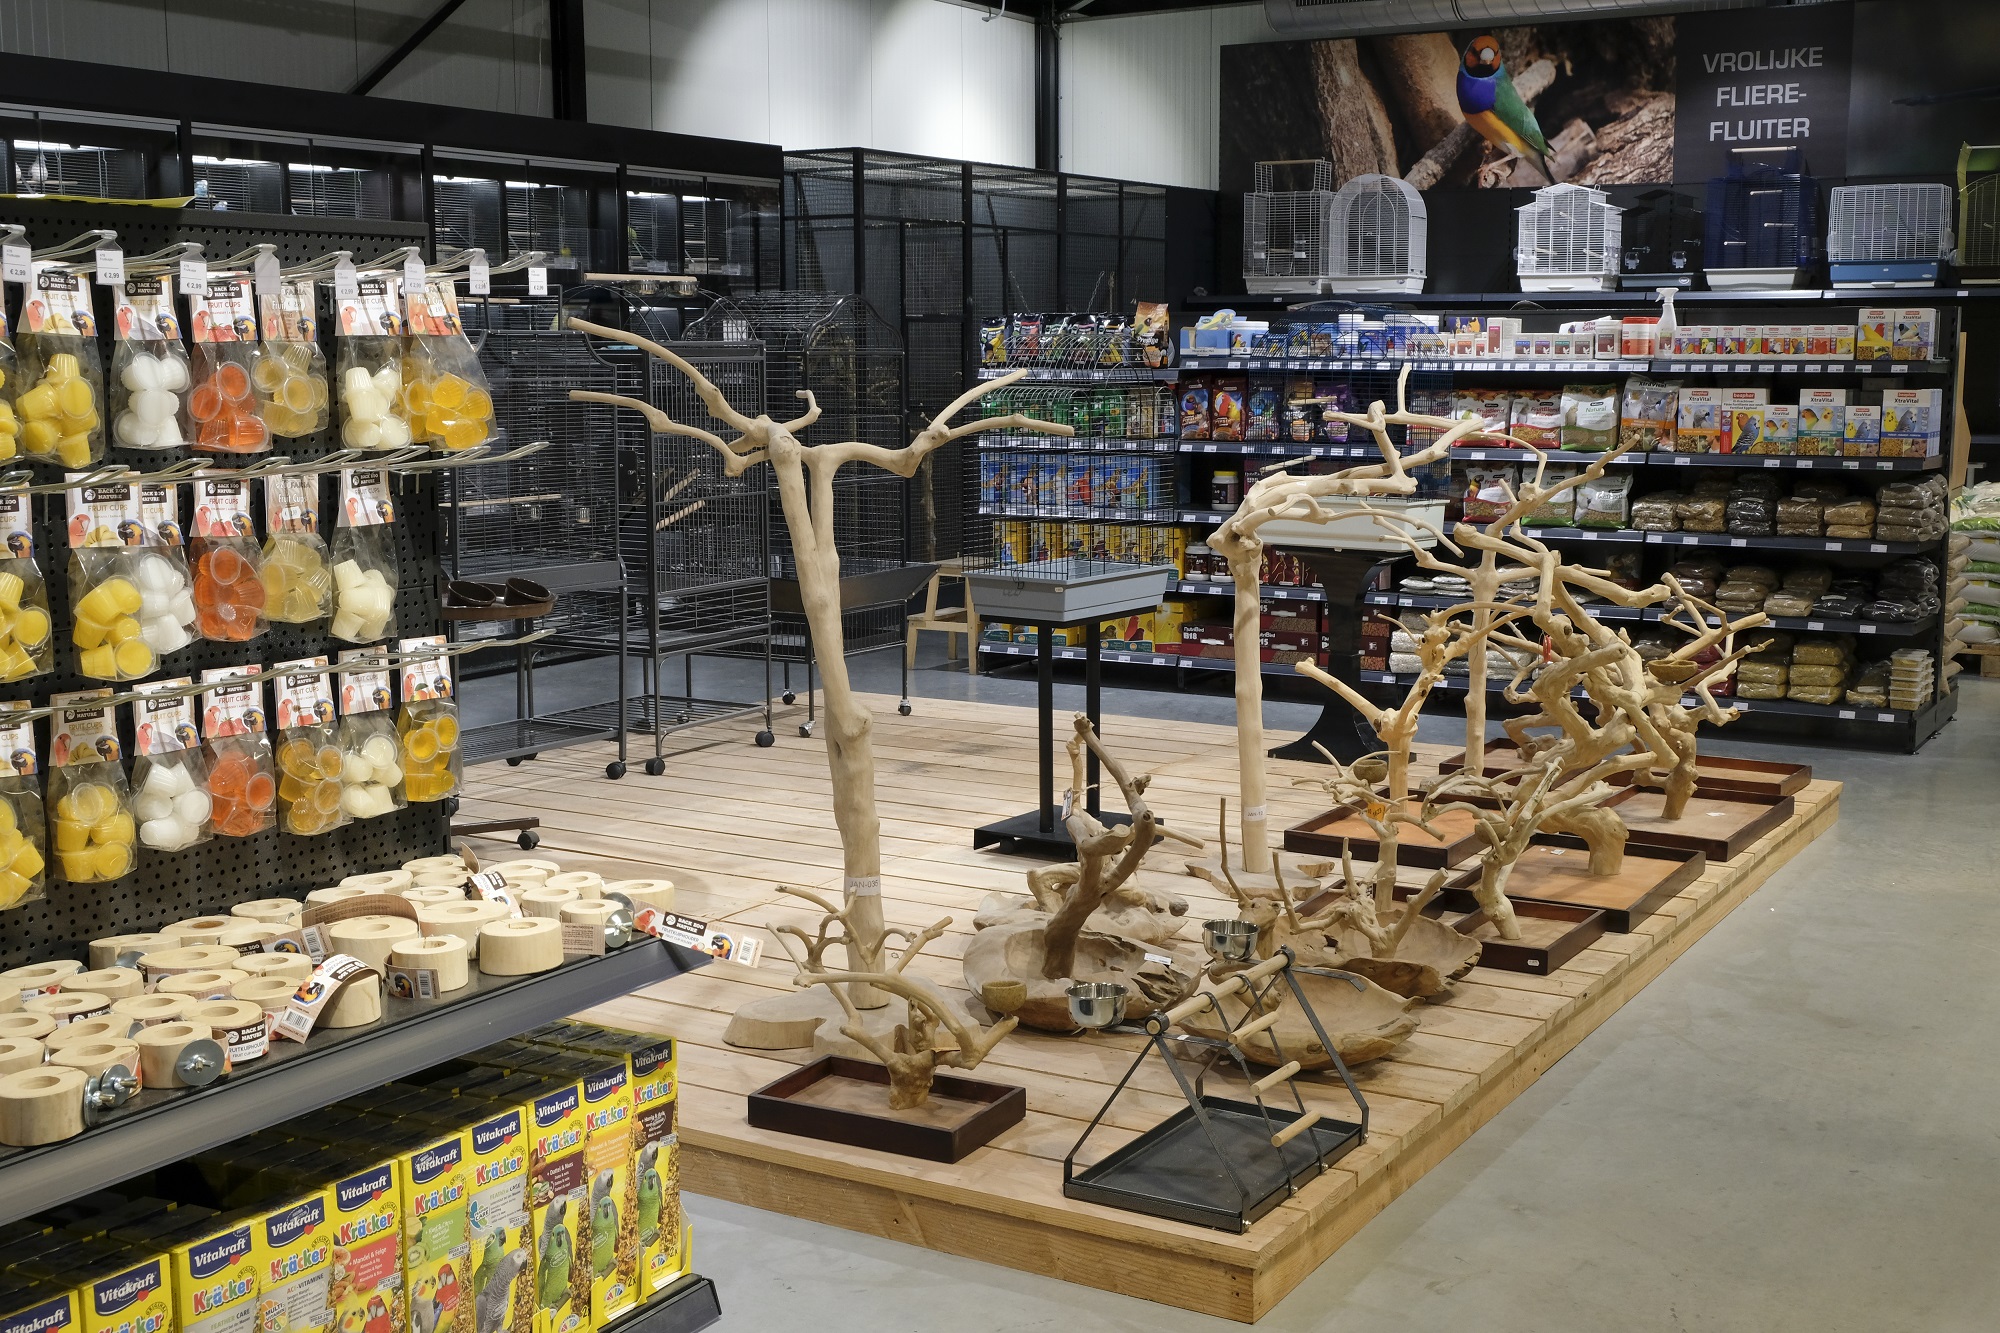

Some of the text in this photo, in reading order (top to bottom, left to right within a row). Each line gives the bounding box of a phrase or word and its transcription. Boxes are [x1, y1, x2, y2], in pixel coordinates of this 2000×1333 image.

[1703, 47, 1823, 73] VROLIJKE
[1716, 83, 1807, 107] FLIERE-
[1709, 118, 1810, 142] FLUITER
[61, 294, 78, 302] CUPS
[355, 488, 368, 496] FRUIT
[88, 504, 108, 512] FRUIT
[368, 674, 379, 682] CUPS
[219, 696, 234, 704] FRUIT
[290, 686, 320, 696] FRUIT CUPS
[69, 722, 103, 731] FRUIT CUPS
[151, 711, 182, 721] FRUIT CUPS
[676, 923, 698, 934] NATURE
[678, 918, 705, 930] BACK ZOO
[242, 1027, 256, 1036] BACK
[242, 1032, 263, 1042] NATURE
[635, 1049, 669, 1068] Vitakraft
[587, 1072, 623, 1093] Vitakraft
[634, 1080, 673, 1106] Kräcker
[539, 1095, 575, 1117] Vitakraft
[586, 1105, 628, 1132] Kräcker
[476, 1121, 517, 1145] Vitakraft
[538, 1129, 581, 1158] Kräcker
[416, 1150, 458, 1175] Vitakraft
[476, 1156, 523, 1187] Kräcker
[341, 1176, 387, 1202] Vitakraft
[415, 1185, 463, 1217] Kräcker
[271, 1209, 320, 1237] Vitakraft
[340, 1211, 394, 1245] Kräcker
[194, 1237, 247, 1268] Vitakraft
[352, 1254, 370, 1266] Mandel
[270, 1246, 327, 1283] Kräcker
[99, 1272, 155, 1305] Vitakraft
[627, 1276, 637, 1288] 2x
[193, 1276, 254, 1315] Kräcker
[5, 1309, 65, 1333] Vitakraft
[236, 1308, 250, 1319] CARE
